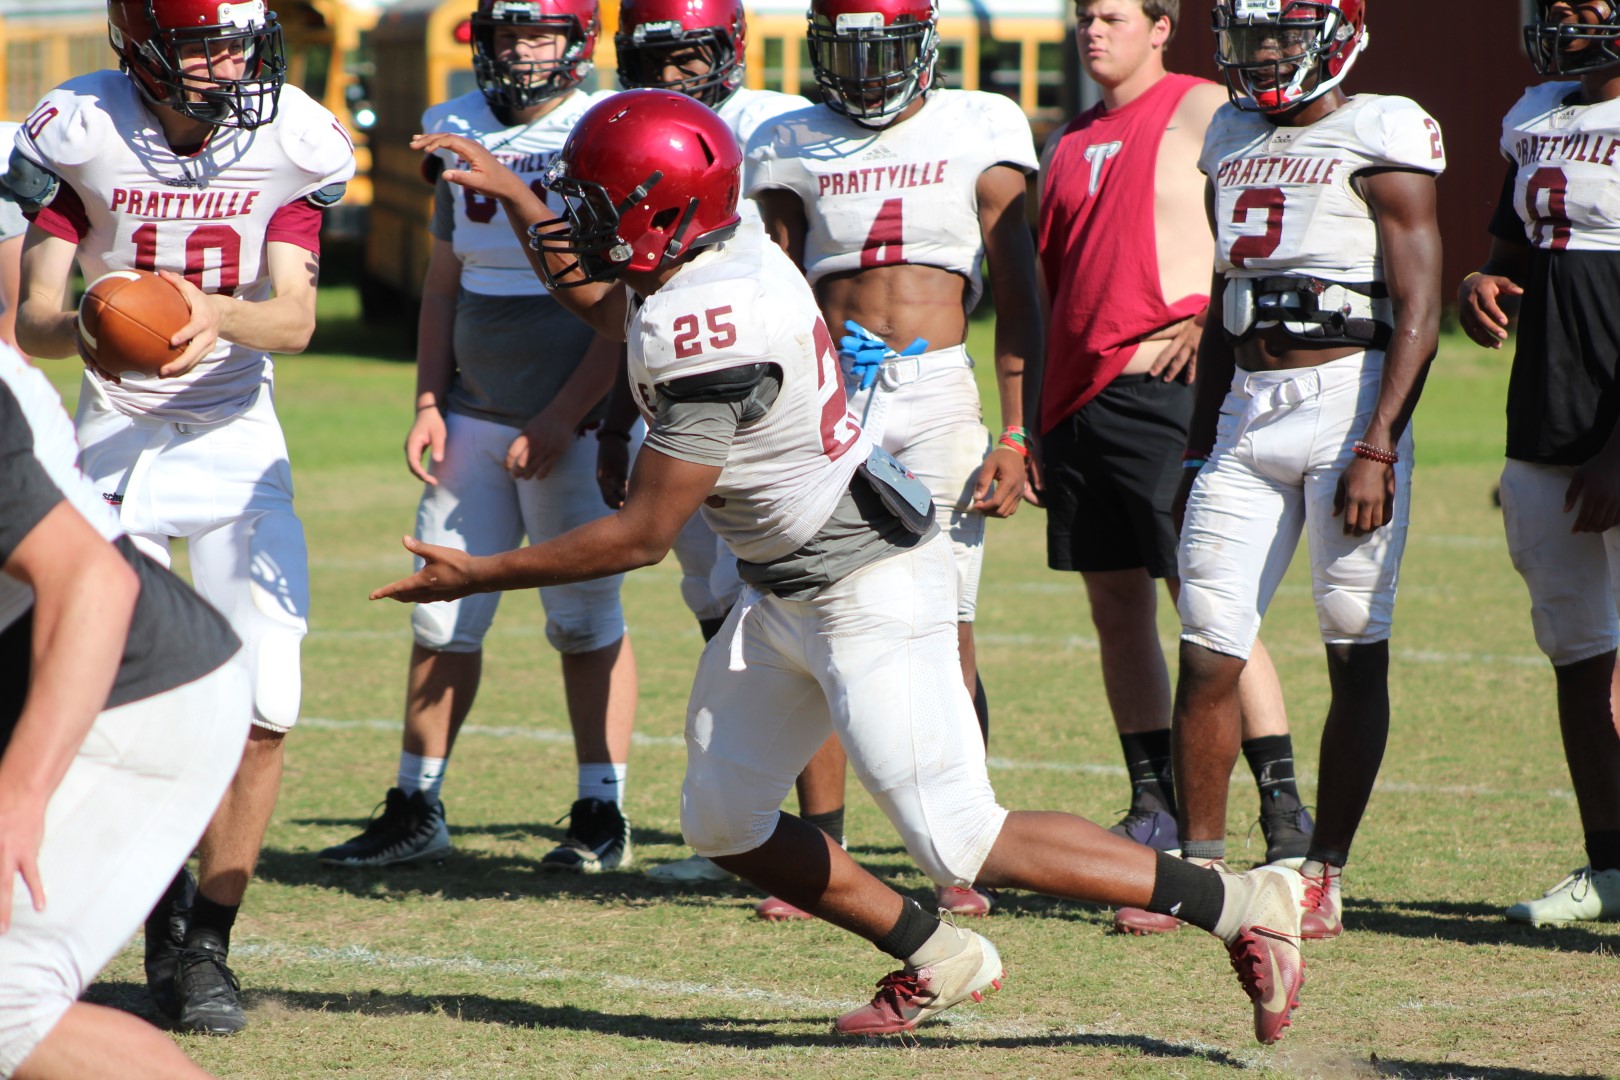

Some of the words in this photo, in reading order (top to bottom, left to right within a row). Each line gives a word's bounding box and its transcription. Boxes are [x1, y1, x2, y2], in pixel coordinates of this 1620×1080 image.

[1423, 118, 1443, 160] 2
[1515, 134, 1620, 167] PRATTVILLE
[818, 159, 948, 197] PRATTVILLE
[1084, 141, 1122, 196] T
[1216, 157, 1343, 187] PRATTVILLE
[109, 188, 261, 219] PRATTVILLE
[1229, 187, 1287, 269] 2
[131, 222, 242, 298] 10
[860, 197, 908, 268] 4
[673, 304, 738, 360] 25
[812, 315, 863, 463] 2
